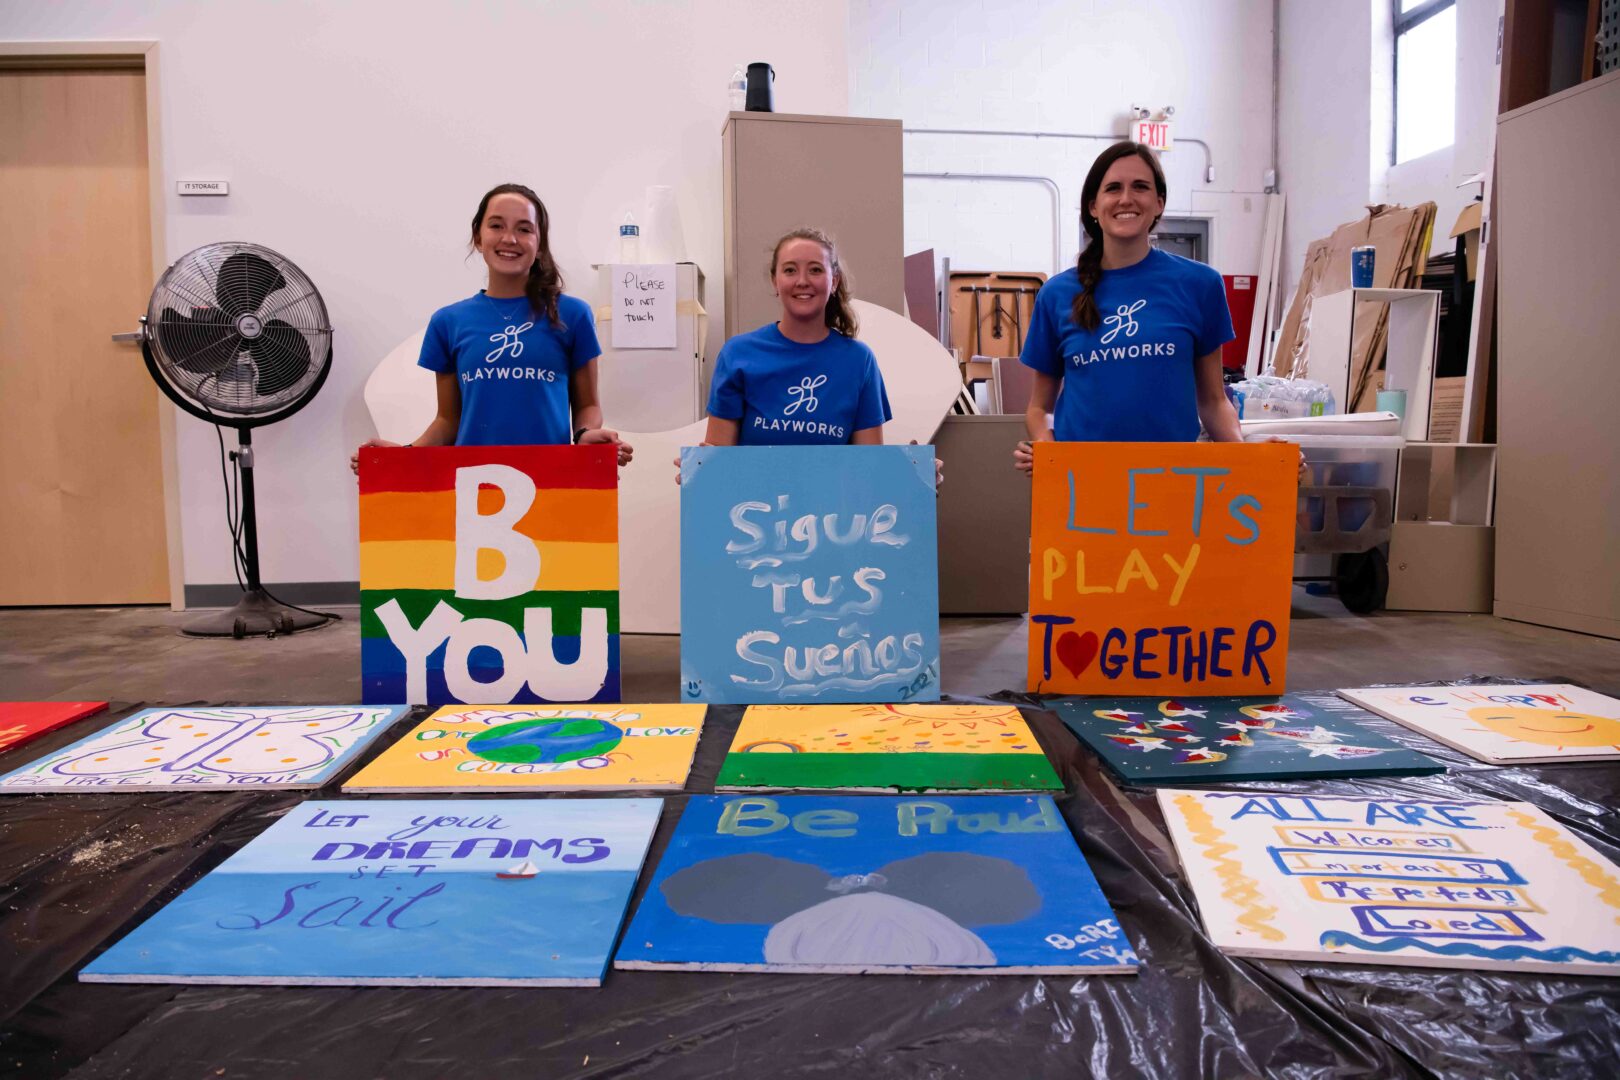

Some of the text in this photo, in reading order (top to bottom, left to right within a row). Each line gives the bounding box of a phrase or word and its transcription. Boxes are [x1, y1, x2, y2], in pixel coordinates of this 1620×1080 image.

[1139, 123, 1168, 147] EXIT
[1073, 343, 1176, 367] PLAYWORKS
[462, 367, 556, 384] PLAYWORKS
[754, 416, 844, 438] PLAYWORKS
[454, 463, 541, 600] B
[725, 494, 912, 566] Sigue
[1043, 543, 1201, 607] PLAY
[373, 597, 609, 704] YOU
[171, 774, 220, 785] BE
[226, 773, 300, 785] YOU!
[716, 797, 1065, 838] Be Proud
[1231, 797, 1354, 822] ALL
[386, 811, 513, 841] your
[312, 836, 612, 863] DREAMS
[350, 864, 438, 880] SET
[216, 880, 447, 931] Sail
